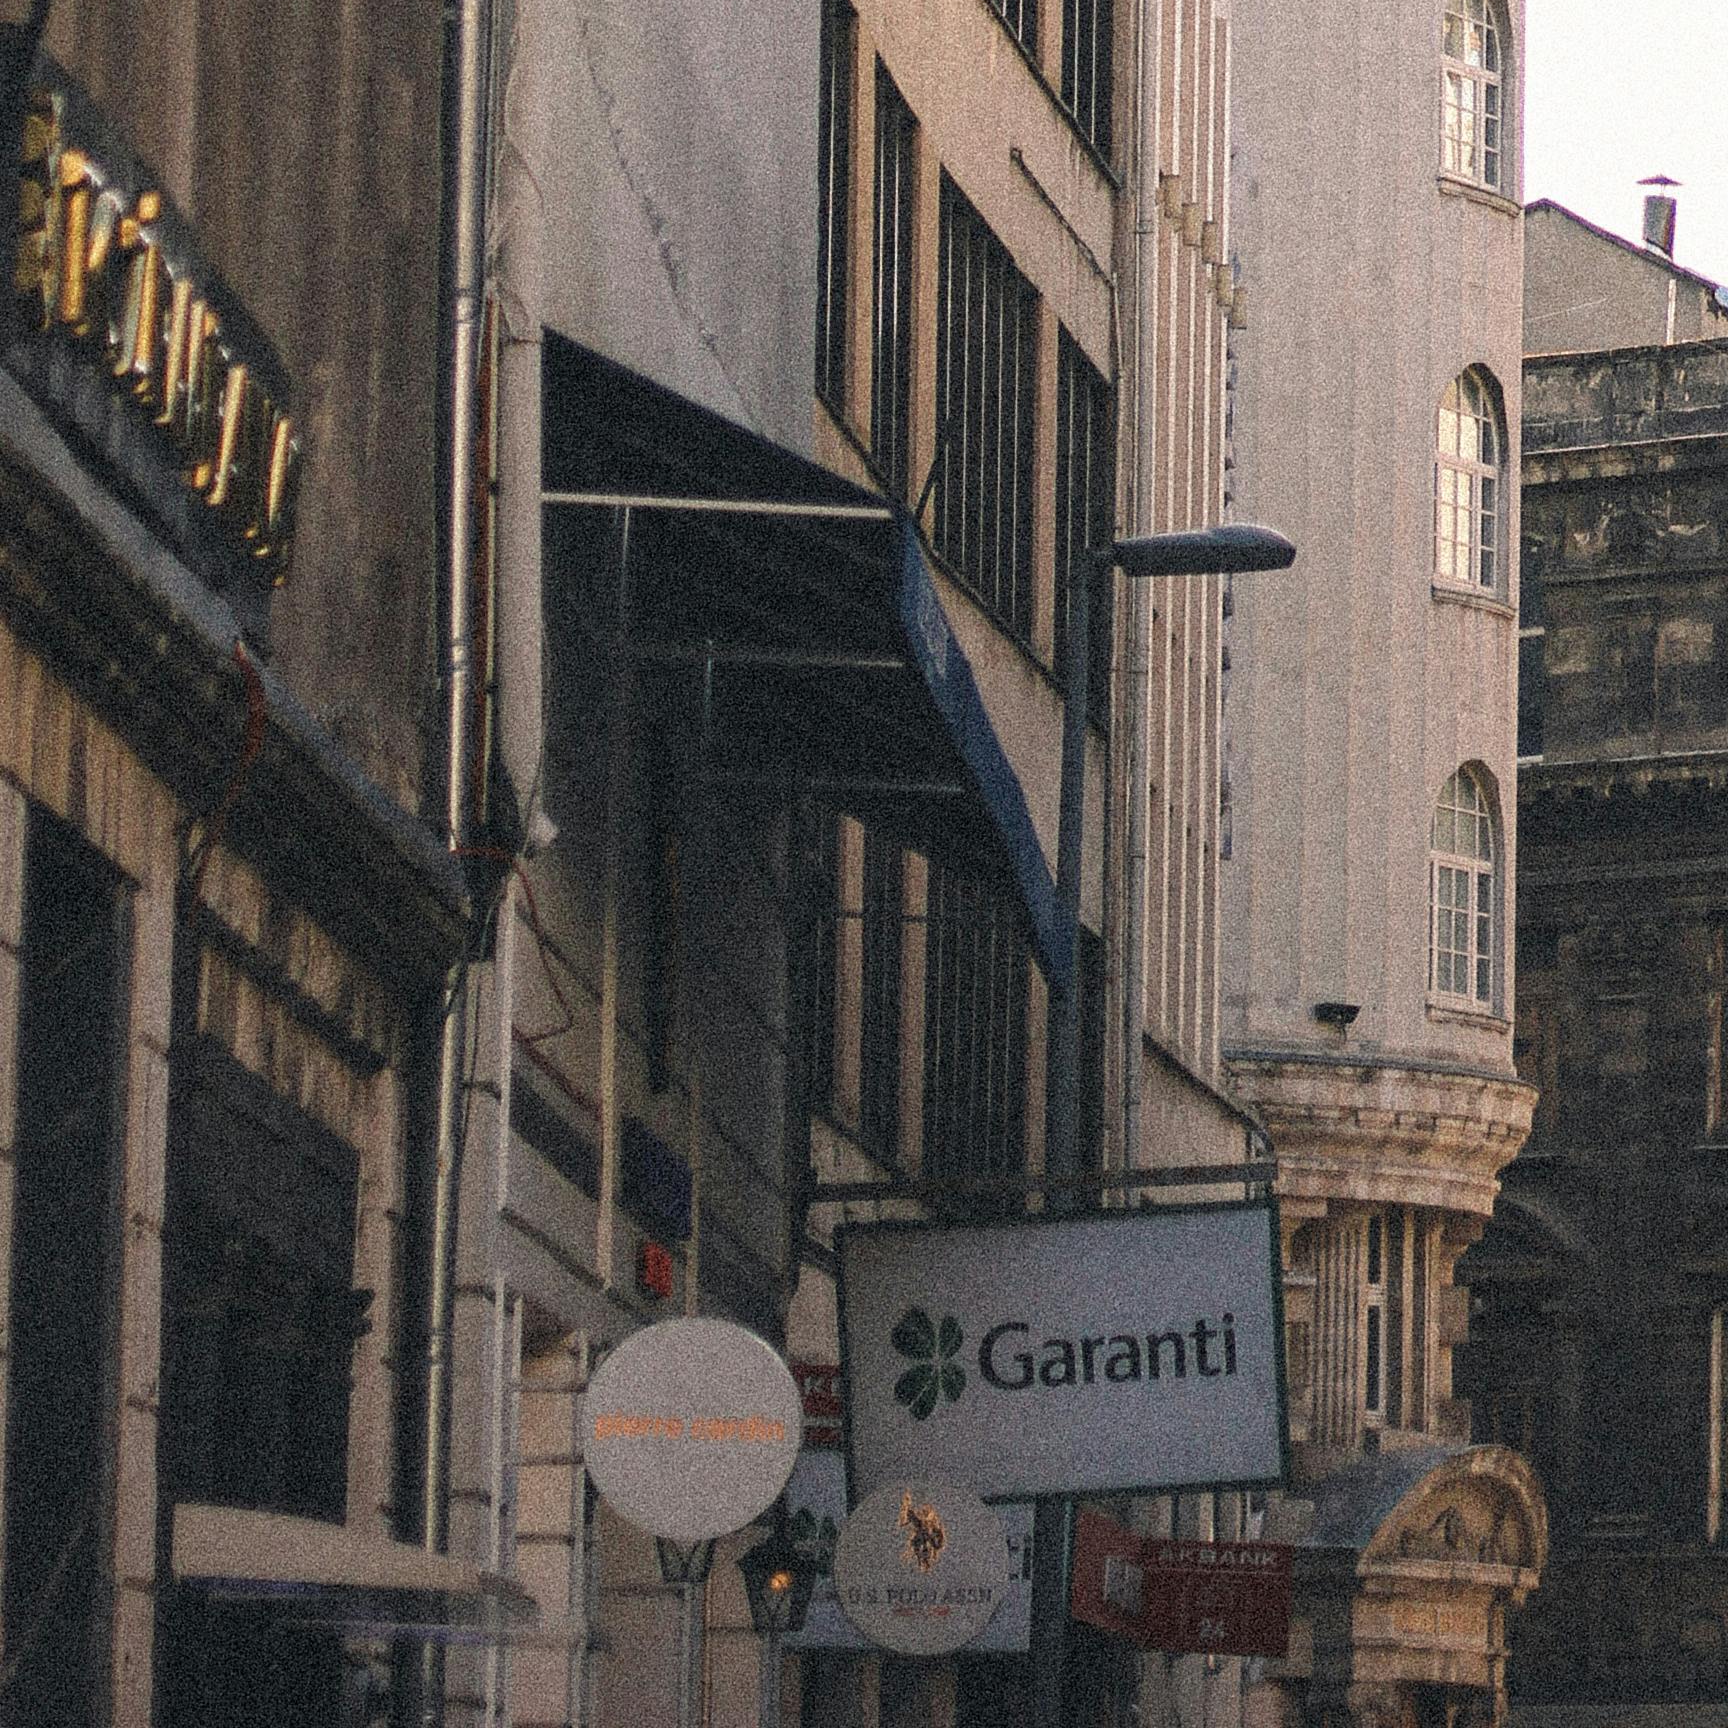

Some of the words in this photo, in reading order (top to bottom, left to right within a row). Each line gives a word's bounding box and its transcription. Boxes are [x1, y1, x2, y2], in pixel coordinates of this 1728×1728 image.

[978, 1312, 1237, 1391] Garanti
[595, 1410, 683, 1441] pierre
[690, 1411, 785, 1442] cardin
[1157, 1546, 1279, 1567] AKBANK
[886, 1585, 938, 1605] POLO
